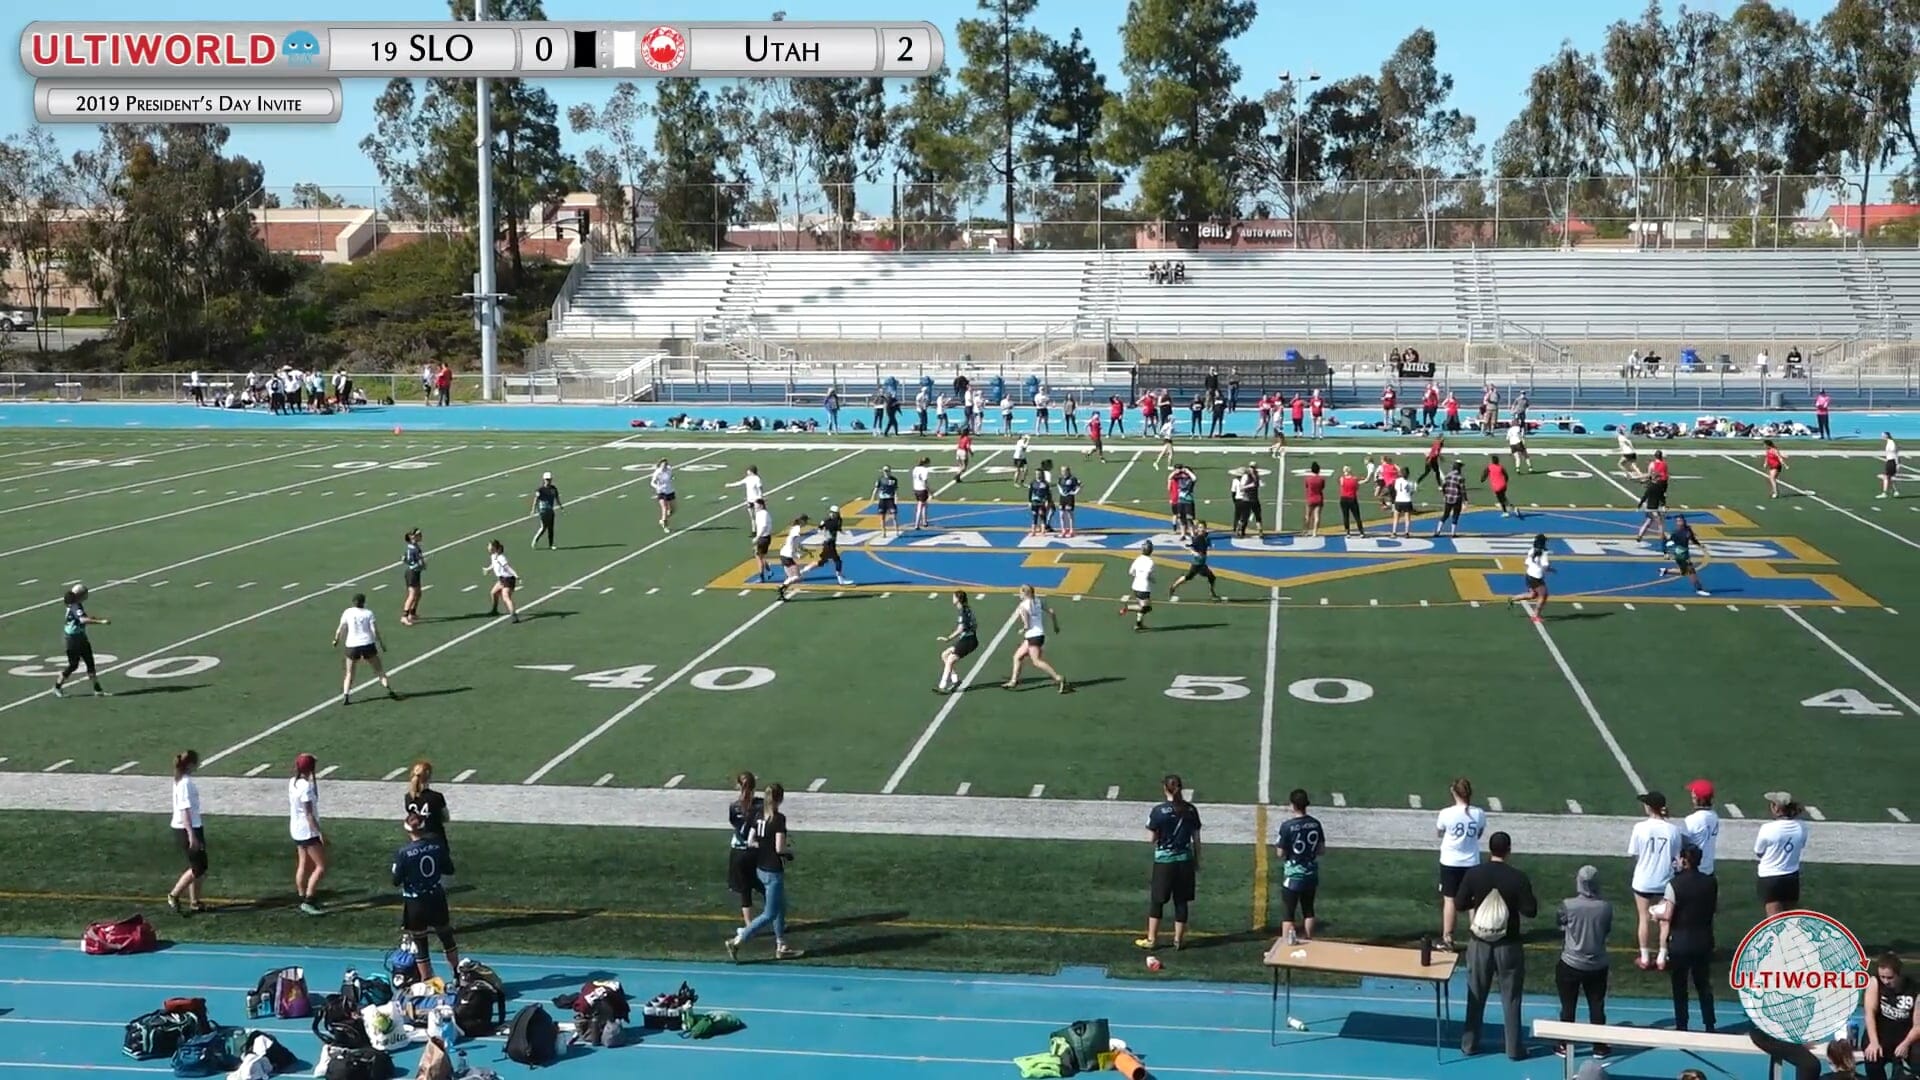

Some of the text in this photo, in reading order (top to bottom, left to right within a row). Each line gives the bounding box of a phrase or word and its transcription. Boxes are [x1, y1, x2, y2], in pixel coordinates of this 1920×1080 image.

[1240, 229, 1262, 238] AUTO
[1265, 229, 1293, 238] PARTS
[571, 664, 776, 691] 40
[1163, 674, 1374, 704] 50
[1800, 688, 1904, 716] 4
[1454, 820, 1478, 839] 85
[1292, 830, 1319, 855] 69
[1650, 836, 1668, 854] 17
[1783, 837, 1795, 853] 6
[419, 854, 436, 878] 0
[1896, 995, 1914, 1010] 39
